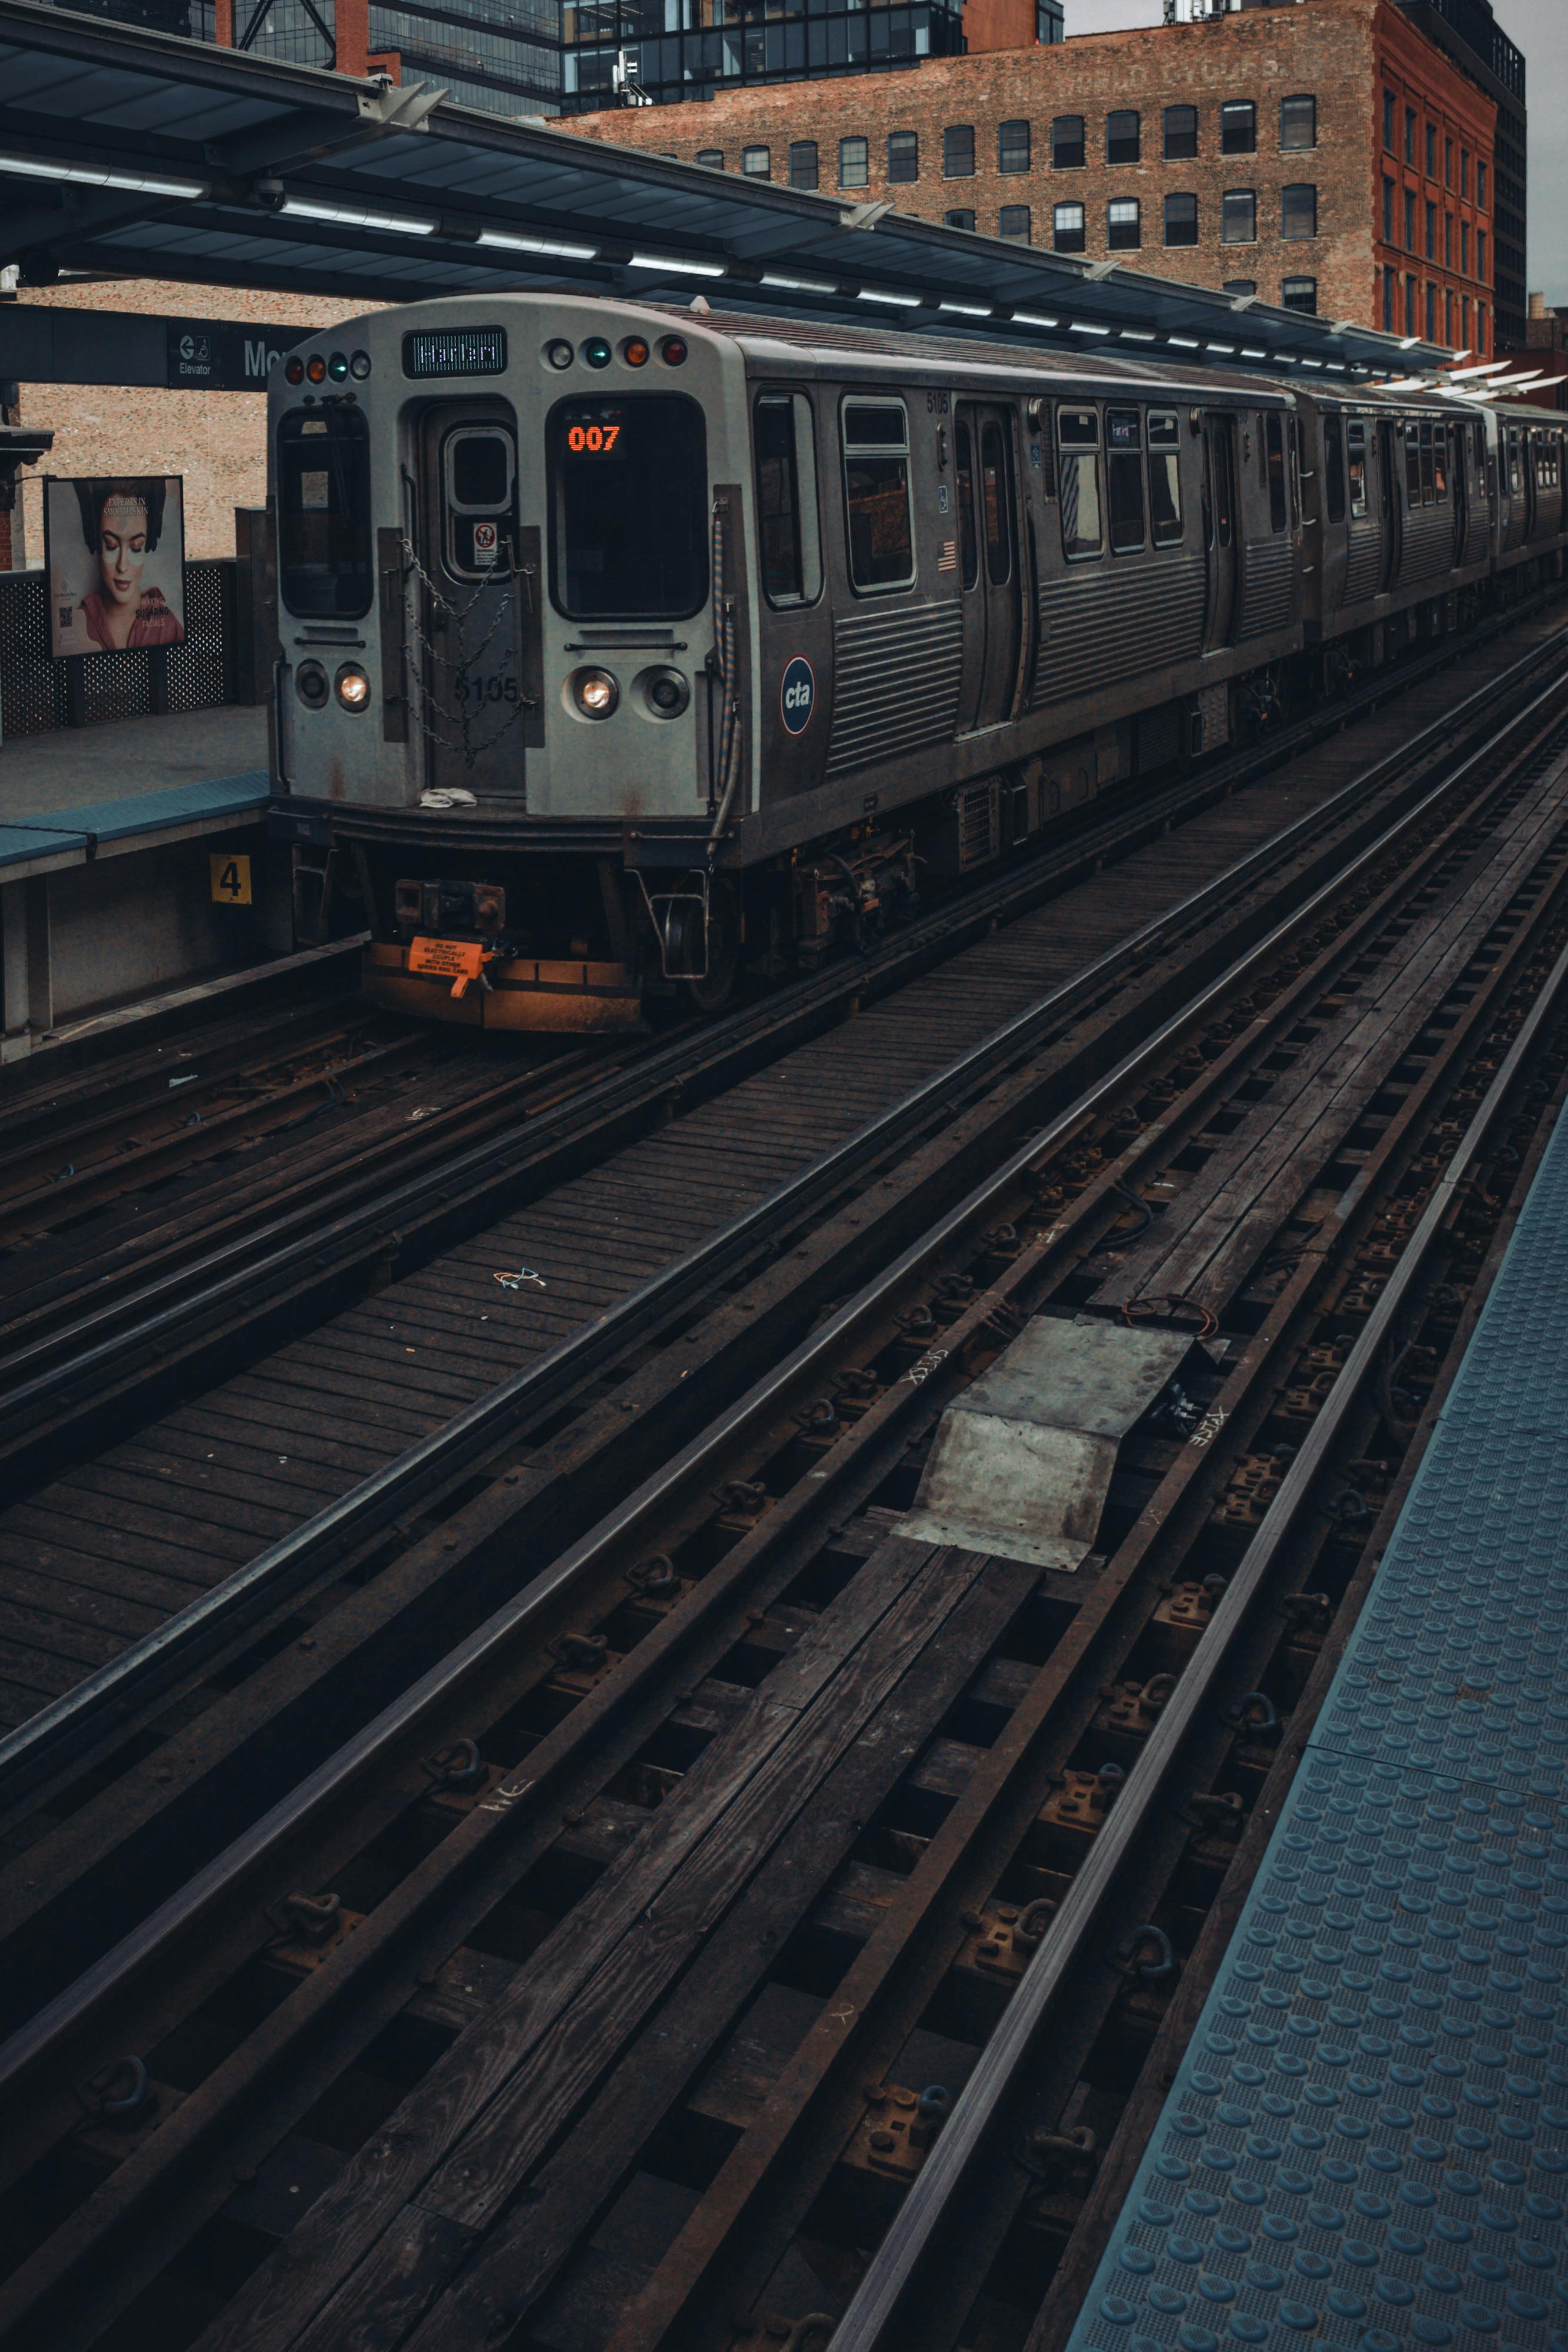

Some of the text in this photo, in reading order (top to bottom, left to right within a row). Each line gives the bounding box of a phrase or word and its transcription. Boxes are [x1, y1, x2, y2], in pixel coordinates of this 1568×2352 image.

[245, 340, 289, 377] Mo
[421, 343, 495, 364] Harlem
[179, 362, 211, 375] Elevator
[927, 392, 948, 414] 5105
[568, 425, 620, 452] 007
[108, 497, 146, 506] EXPERTS IN
[104, 506, 148, 516] SMOOTH SKIN
[141, 597, 165, 606] WAXING
[135, 606, 170, 618] SUGARING
[141, 618, 165, 628] FACIALS
[785, 681, 810, 709] cta
[219, 862, 242, 897] 4
[424, 947, 466, 957] ELECTRICALLY
